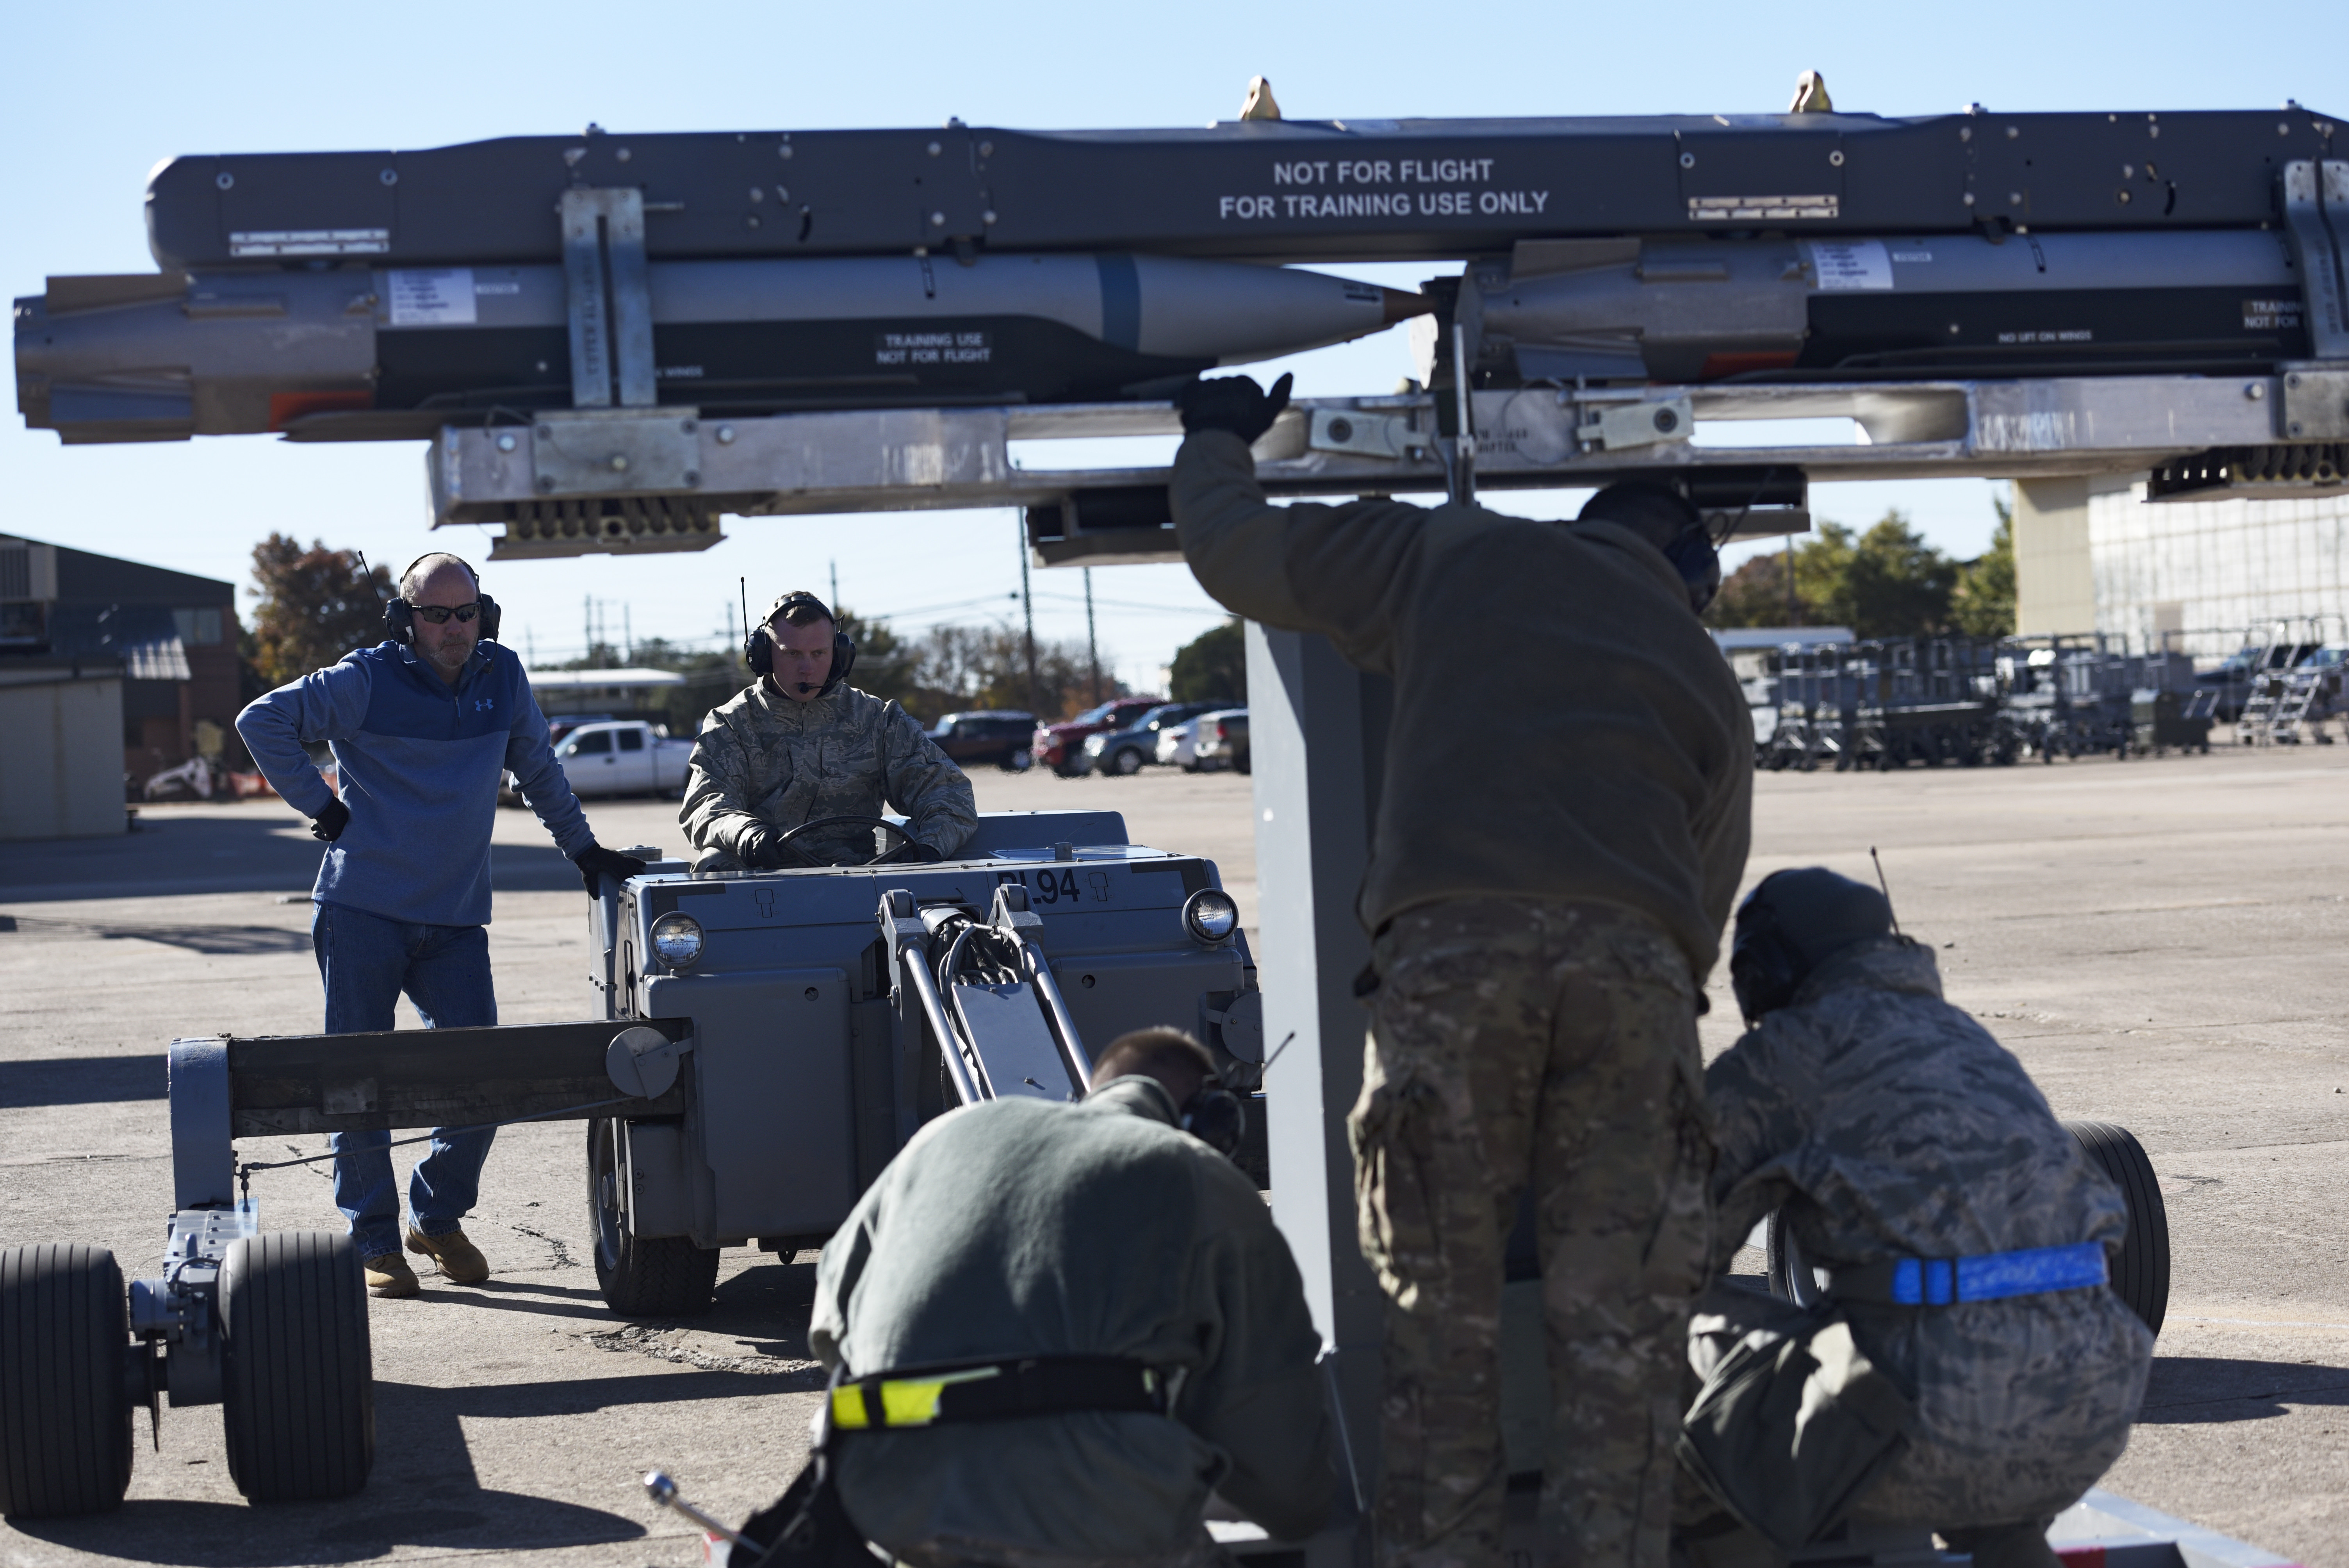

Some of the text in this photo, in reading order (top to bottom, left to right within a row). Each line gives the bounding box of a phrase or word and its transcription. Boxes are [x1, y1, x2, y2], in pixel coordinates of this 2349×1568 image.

[1274, 159, 1494, 185] NOT FOR FLIGHT
[1219, 191, 1549, 219] FOR TRAINING USE ONLY
[2244, 316, 2299, 328] NOT FOR
[885, 332, 983, 347] TRAINING USE
[1998, 332, 2016, 344] NO
[2038, 331, 2056, 342] ON
[2057, 330, 2092, 341] WINGS
[876, 347, 991, 364] NOT FOR FLIGHT
